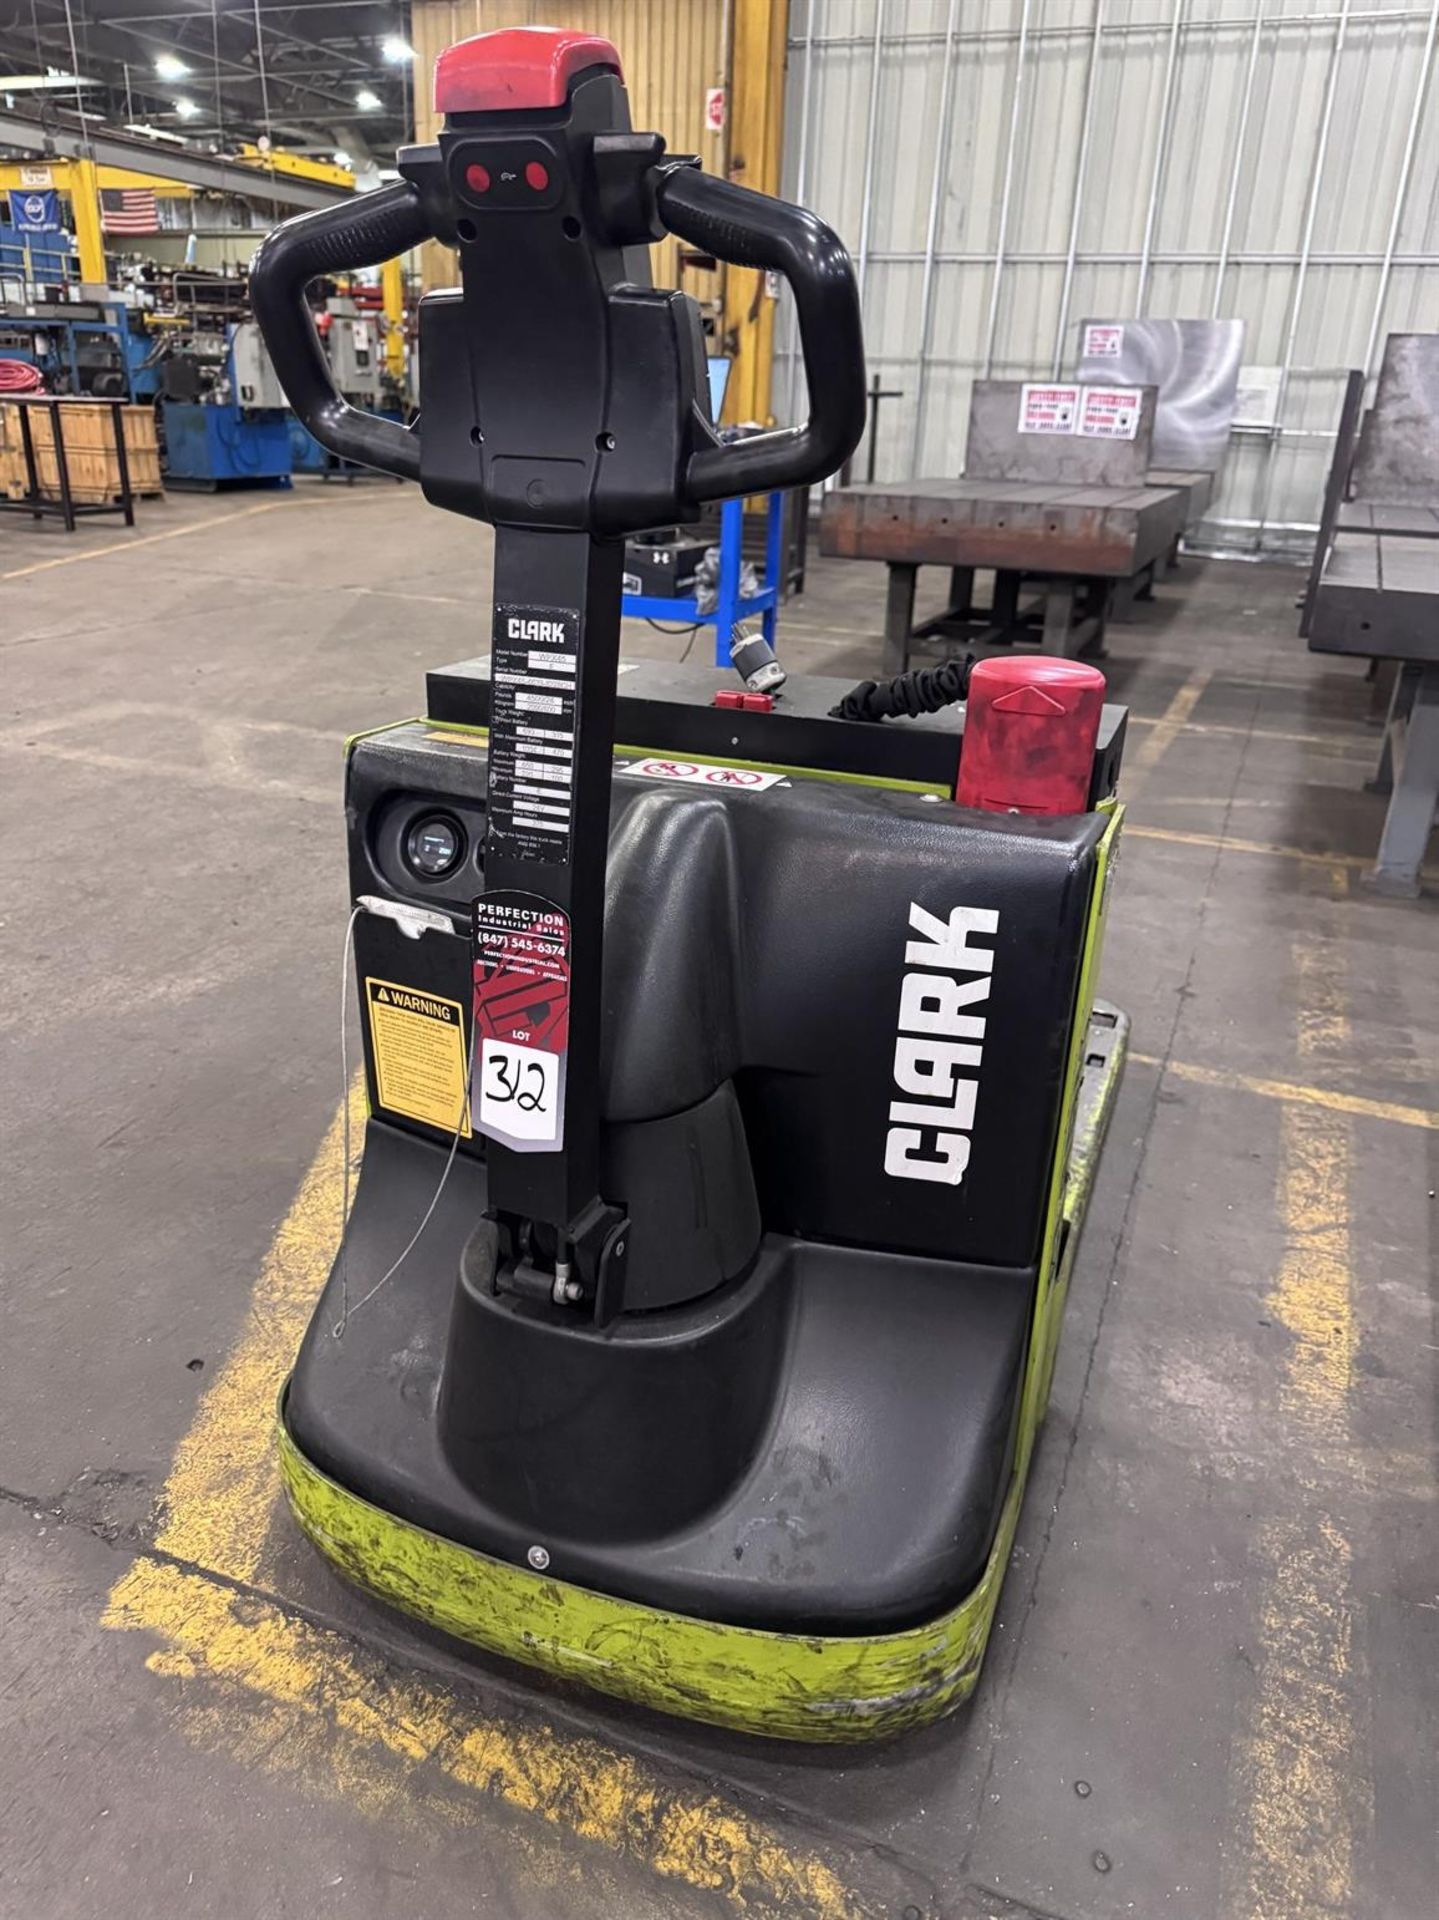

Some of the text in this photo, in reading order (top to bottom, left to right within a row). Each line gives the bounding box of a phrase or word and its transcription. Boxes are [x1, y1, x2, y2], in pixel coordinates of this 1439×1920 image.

[508, 618, 565, 643] CLARK
[478, 903, 564, 927] PERFECTION
[478, 915, 564, 936] Industrial Sales
[478, 932, 566, 958] (847) 545-6374
[390, 990, 452, 1020] WARNING
[512, 1030, 530, 1042] LOT
[884, 901, 1000, 1186] CLARK
[485, 1055, 547, 1113] 312
